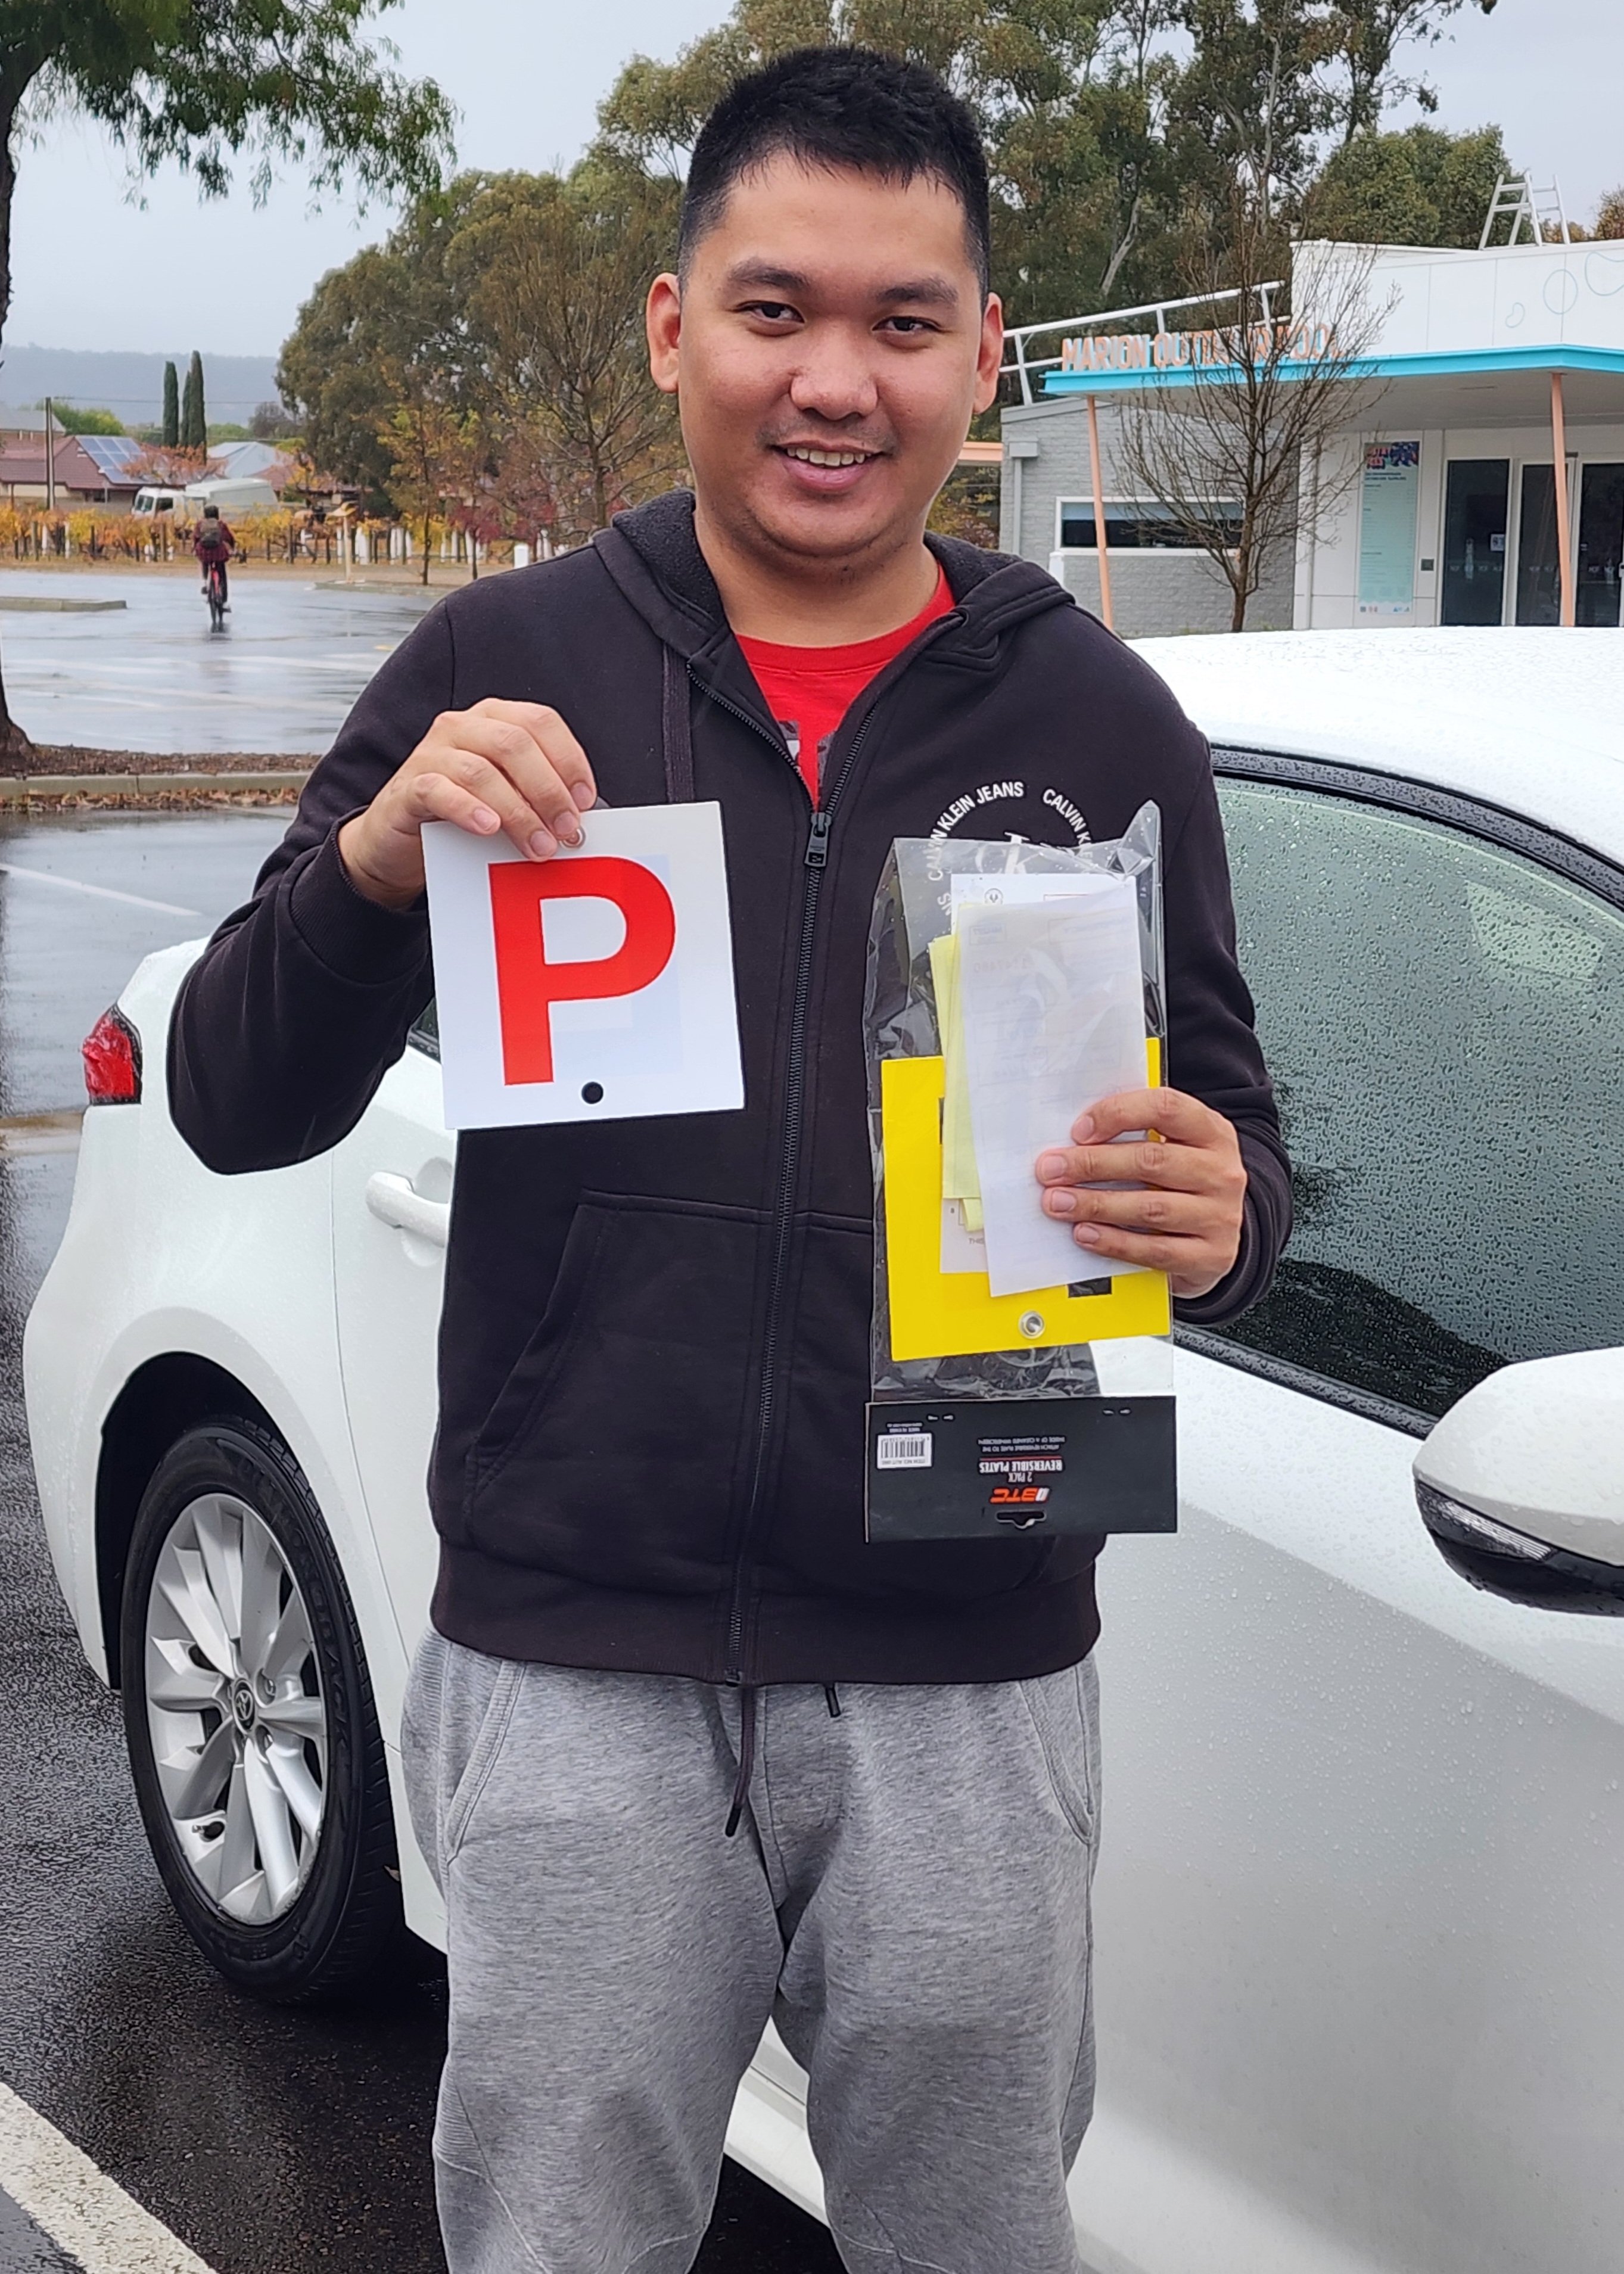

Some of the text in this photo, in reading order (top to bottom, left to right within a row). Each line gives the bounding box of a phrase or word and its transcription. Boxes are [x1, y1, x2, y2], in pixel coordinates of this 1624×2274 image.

[1062, 334, 1151, 372] MARION
[1043, 788, 1087, 832] CALVIN
[926, 781, 1024, 881] CALVIN KLEIN JEANS
[488, 856, 676, 1086] P
[979, 1460, 1063, 1474] REVERSIBLE PLATES
[1007, 1472, 1032, 1483] 2 PACK
